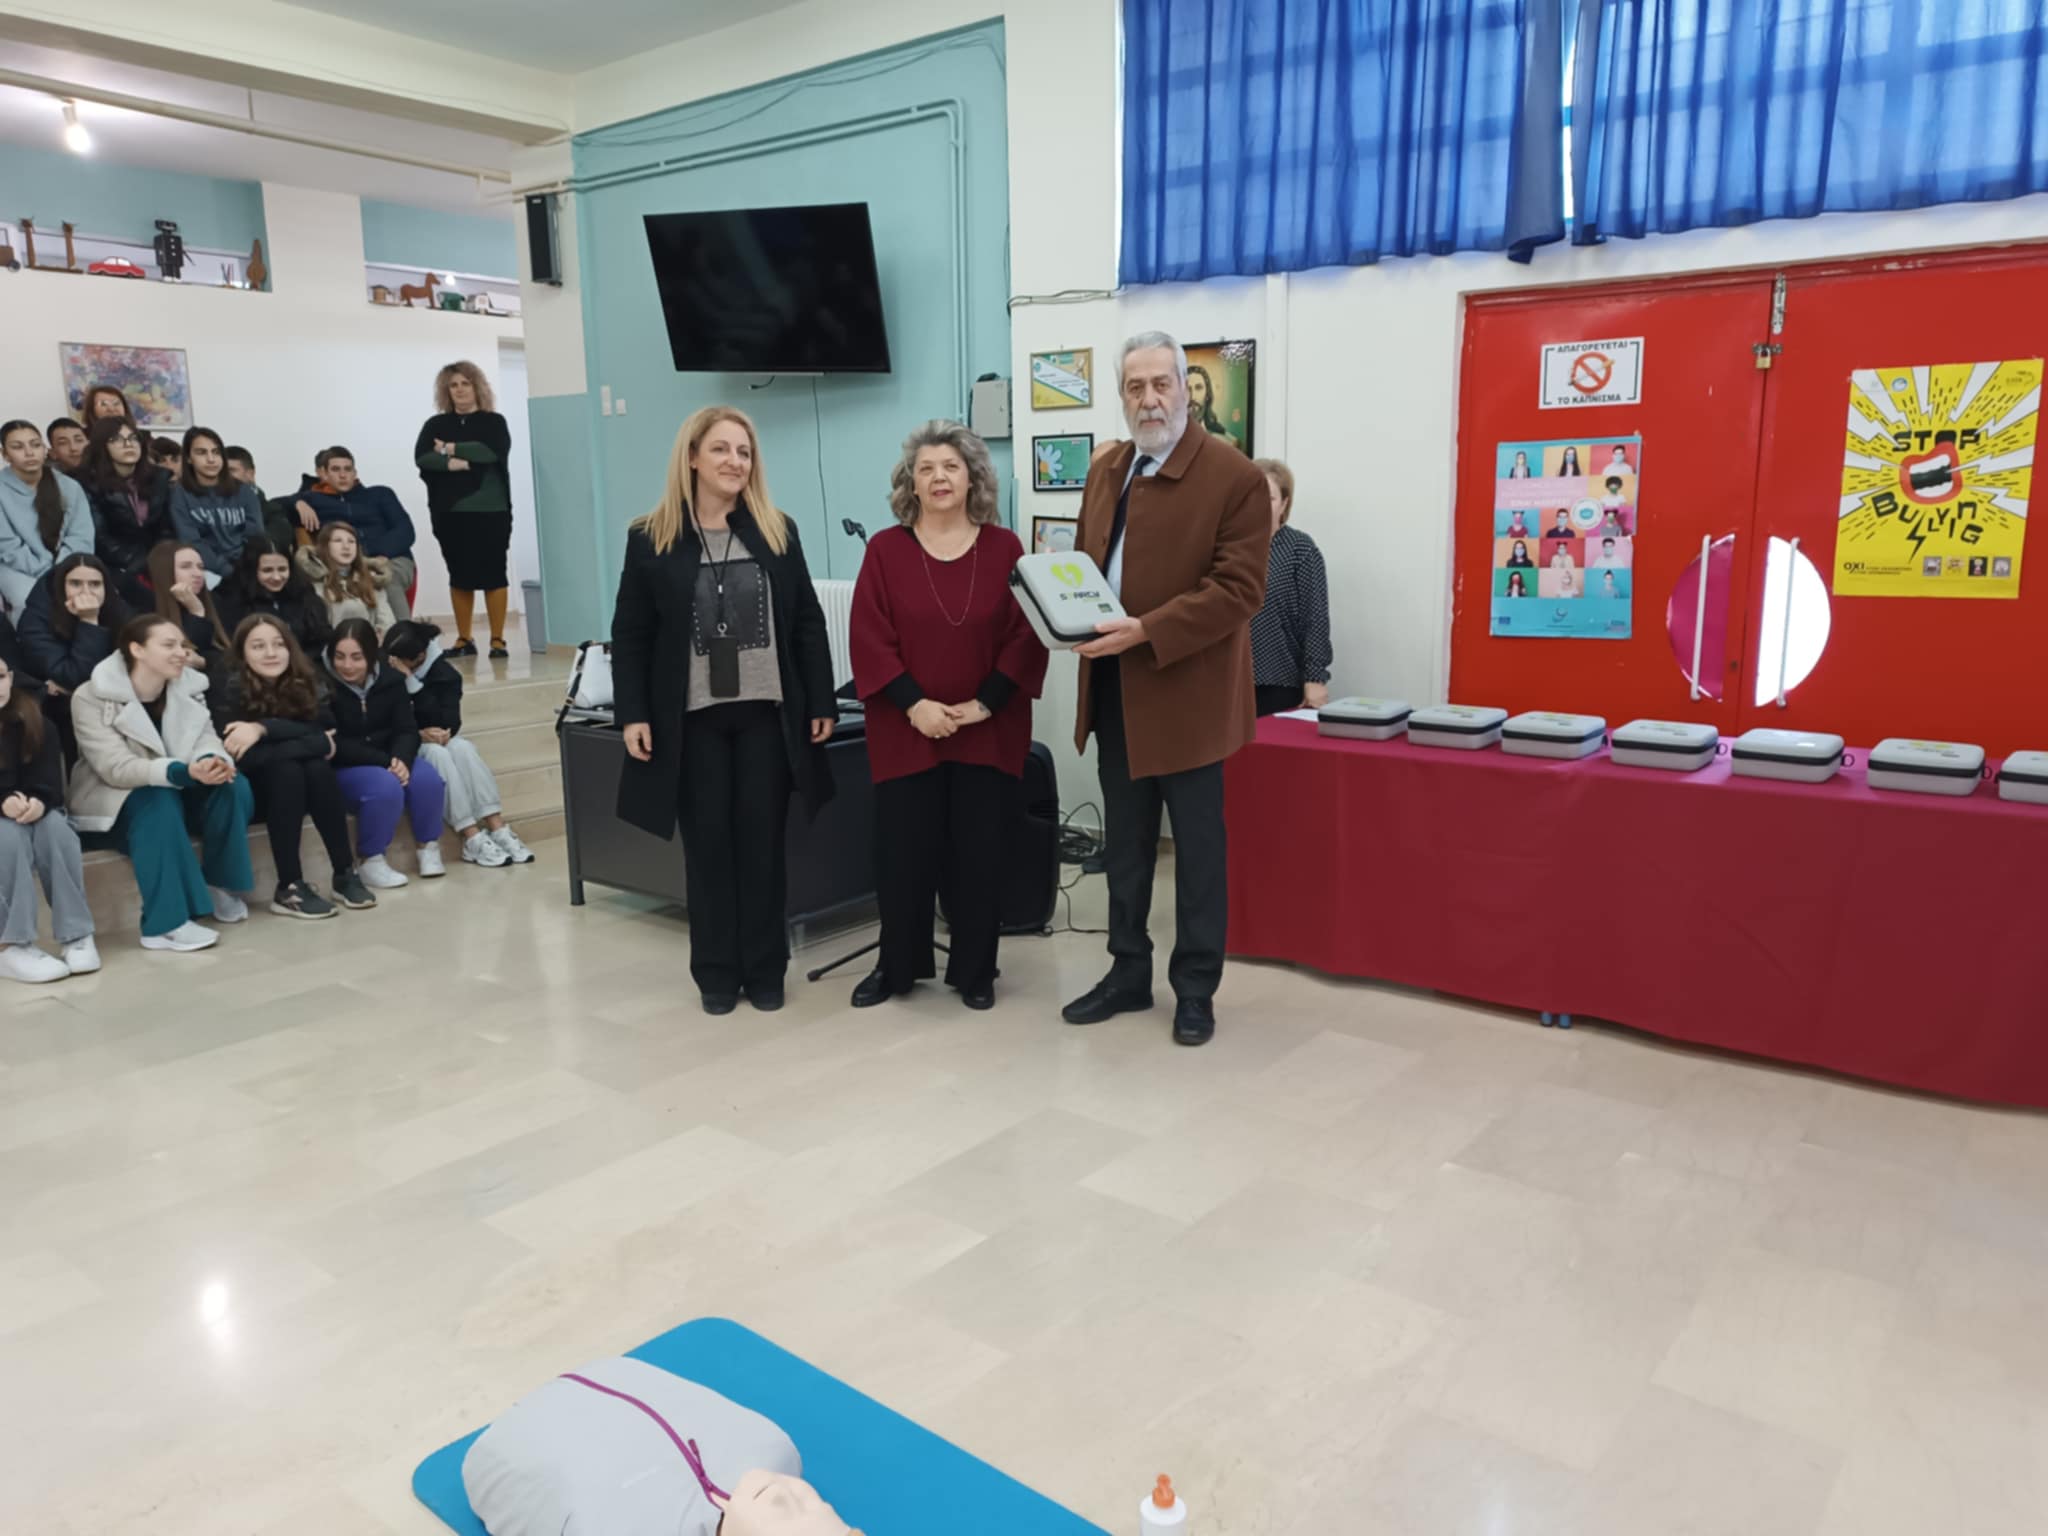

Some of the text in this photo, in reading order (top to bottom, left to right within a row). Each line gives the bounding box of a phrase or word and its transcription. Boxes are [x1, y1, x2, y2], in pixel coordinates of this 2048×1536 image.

[1557, 340, 1628, 353] ΑΠΑΓΟΡΕΥΕΤΑΙ
[1557, 393, 1622, 405] ΤΟ ΚΑΠΝΙΣΜΑ
[1892, 428, 1982, 452] STOP
